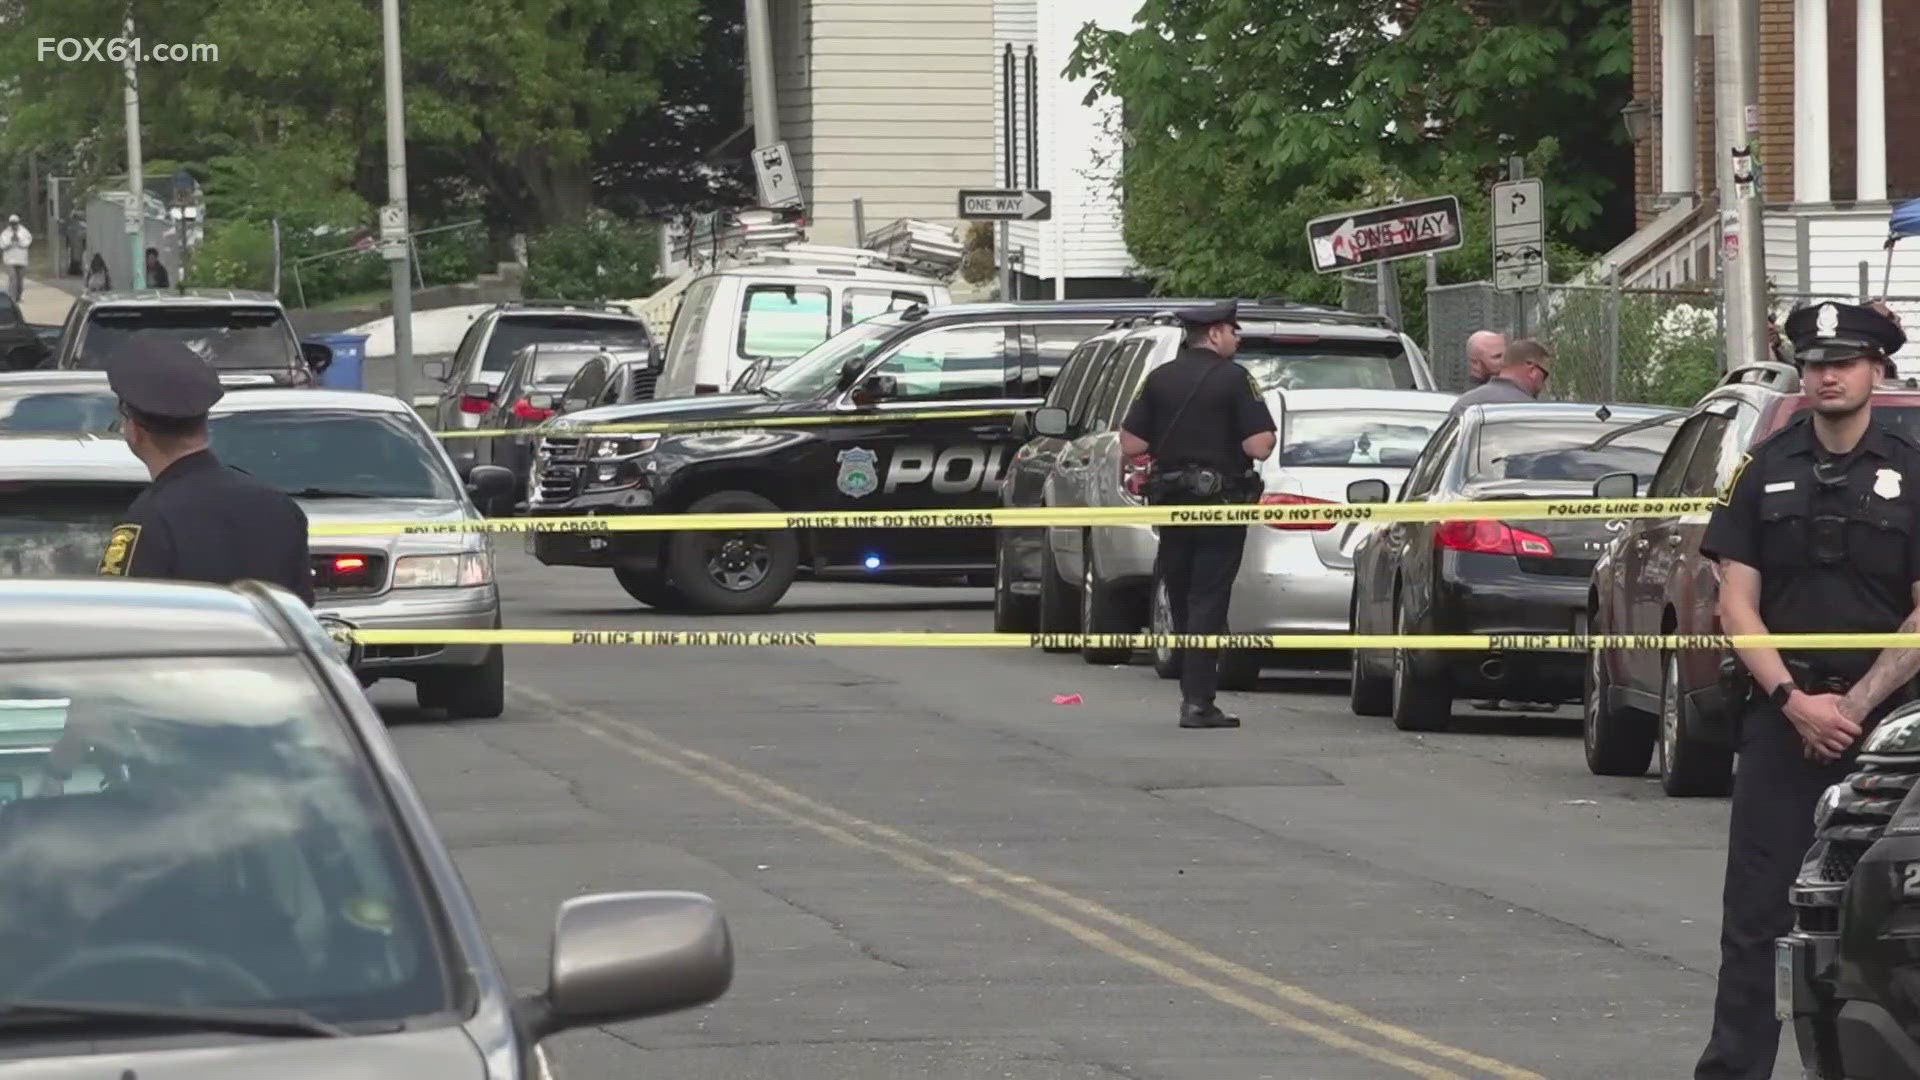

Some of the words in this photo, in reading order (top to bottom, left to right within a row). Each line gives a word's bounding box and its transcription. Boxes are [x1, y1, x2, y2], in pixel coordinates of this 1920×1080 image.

[967, 199, 992, 211] ONE
[996, 199, 1022, 211] WAY
[1355, 223, 1393, 248] ONE
[1403, 213, 1445, 239] WAY
[1170, 510, 1223, 522] POLICE
[1227, 509, 1260, 521] LINE
[1264, 509, 1284, 520] DO
[1289, 508, 1320, 520] NOT
[1323, 507, 1372, 519] CROSS
[1547, 504, 1602, 515] POLICE
[1605, 503, 1639, 513] LINE
[1644, 502, 1664, 512] DO
[1669, 502, 1701, 512] NOT
[404, 526, 457, 534] POLICE
[462, 525, 494, 533] LINE
[499, 523, 520, 532] DO
[525, 522, 556, 532] NOT
[559, 520, 609, 531] CROSS
[786, 517, 840, 528] POLICE
[845, 517, 877, 527] LINE
[883, 516, 904, 527] DO
[909, 515, 938, 526] NOT
[944, 513, 993, 525] CROSS
[572, 633, 634, 646] POLICE
[641, 633, 681, 646] LINE
[686, 633, 710, 646] DO
[717, 633, 751, 646] NOT
[757, 633, 816, 646] CROSS
[1030, 634, 1093, 648] POLICE
[1099, 634, 1137, 648] LINE
[1143, 634, 1168, 648] DO
[1174, 634, 1208, 648] NOT
[1216, 634, 1274, 648] CROSS
[1488, 635, 1551, 649] POLICE
[1557, 635, 1597, 649] LINE
[1602, 635, 1627, 649] DO
[1633, 635, 1669, 649] NOT
[1676, 635, 1734, 649] CROSS
